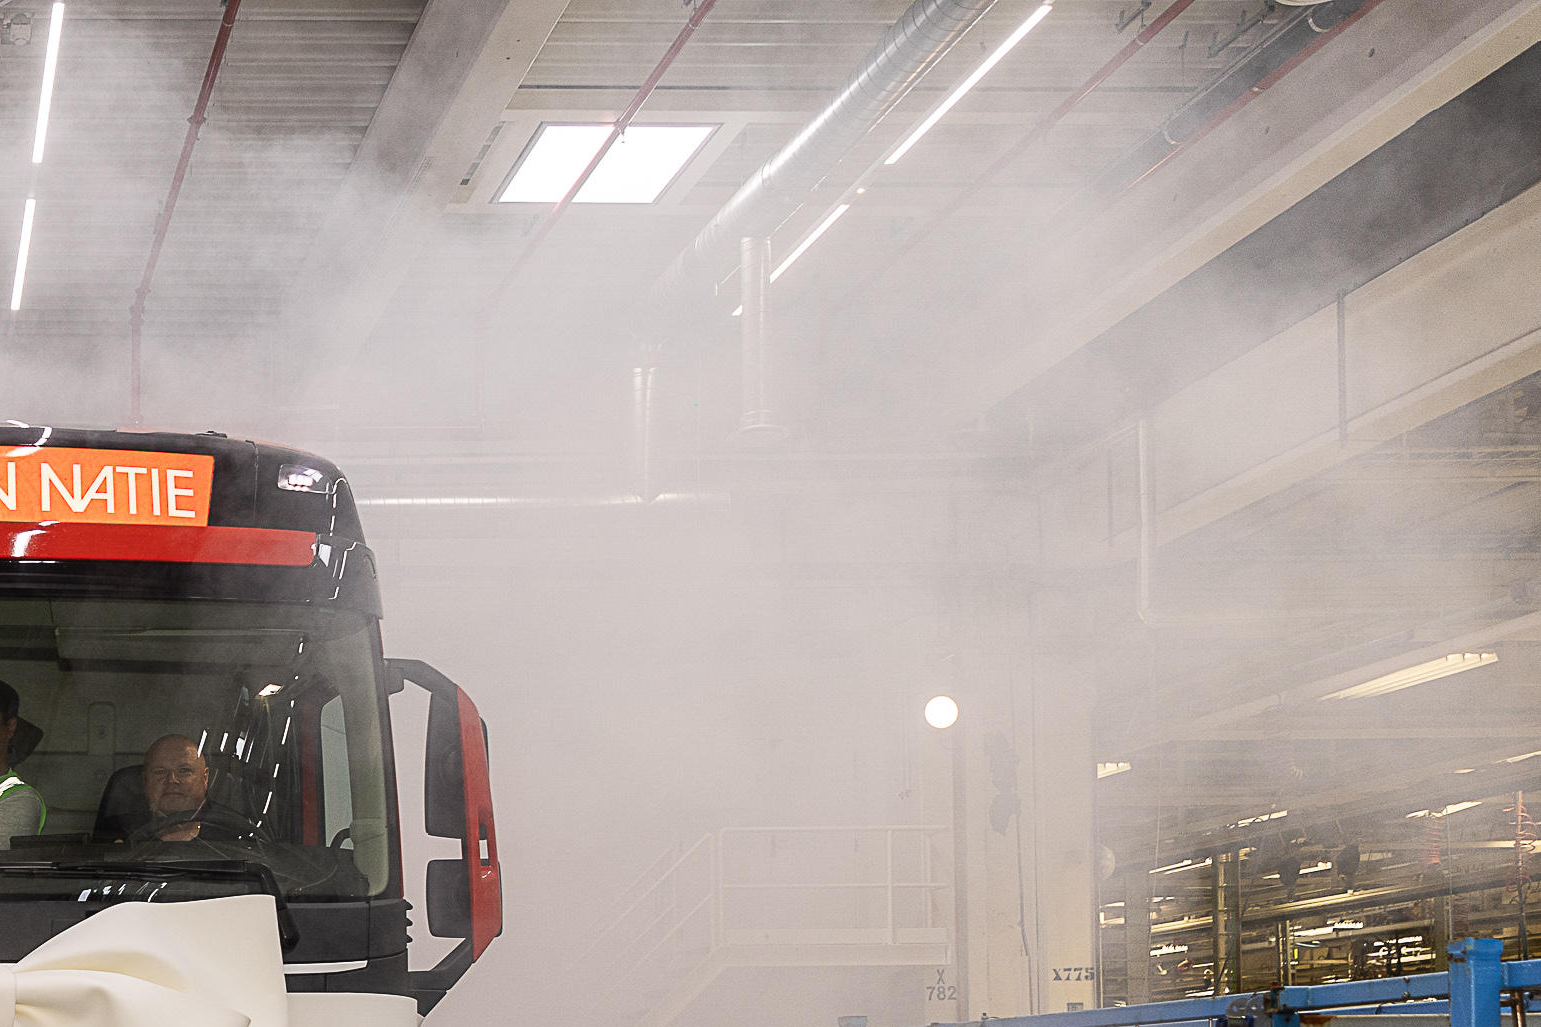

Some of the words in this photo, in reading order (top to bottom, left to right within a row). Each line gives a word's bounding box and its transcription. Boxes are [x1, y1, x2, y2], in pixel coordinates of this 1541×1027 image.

[40, 462, 197, 518] NATIE
[936, 969, 946, 985] X
[1052, 967, 1095, 982] X775
[926, 986, 957, 1001] 782
